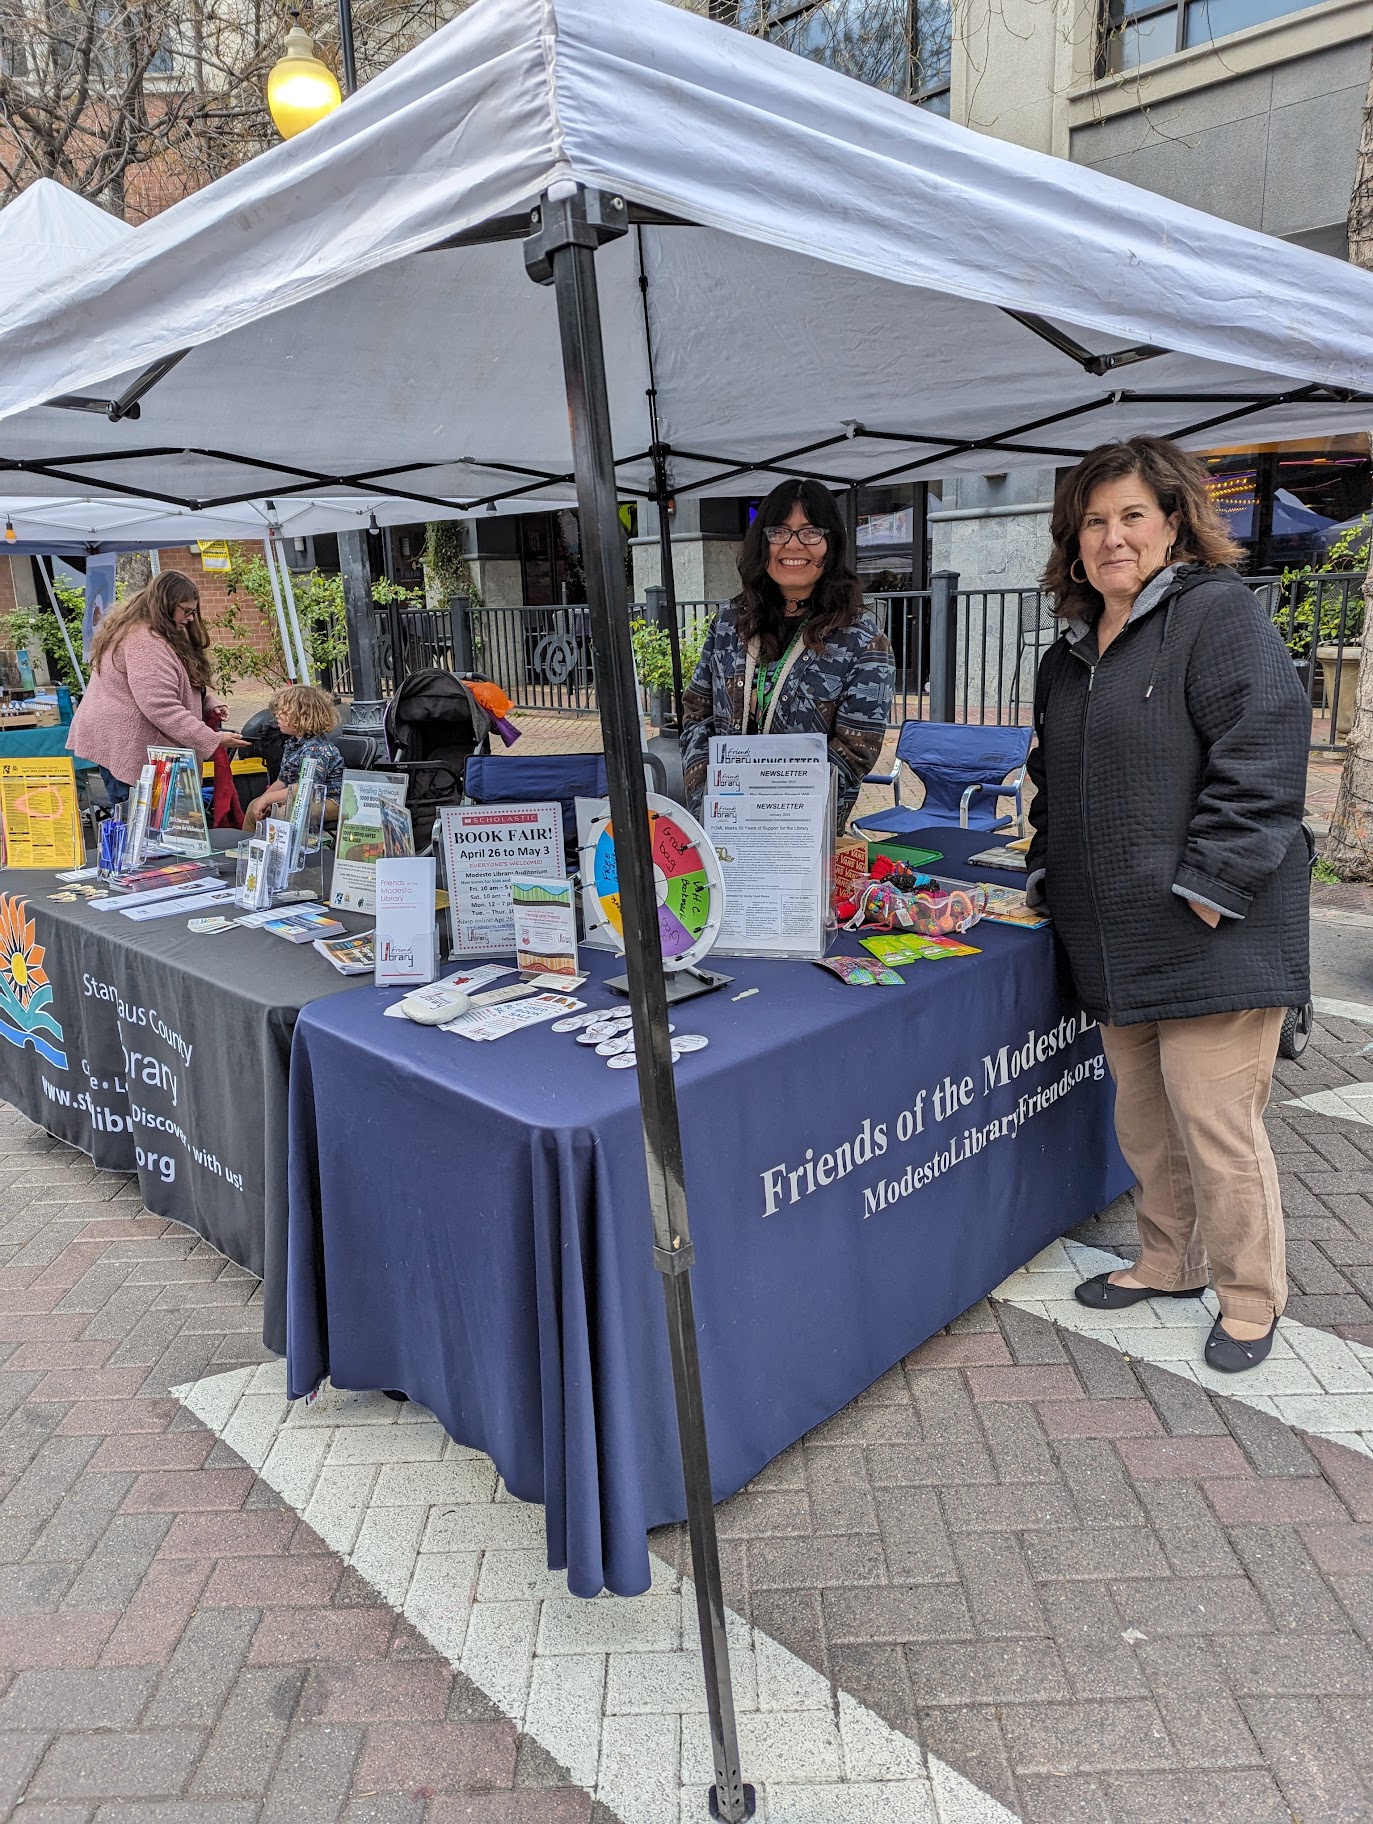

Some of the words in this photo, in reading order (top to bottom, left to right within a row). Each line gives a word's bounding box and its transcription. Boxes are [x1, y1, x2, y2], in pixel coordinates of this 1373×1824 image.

[473, 815, 537, 824] SCHOLASTIC
[763, 825, 779, 833] Support
[793, 825, 809, 833] Library
[454, 829, 503, 845] BOOK
[507, 827, 553, 842] FAIR!
[460, 849, 485, 860] April
[488, 848, 501, 858] 26
[504, 849, 515, 857] to
[518, 846, 541, 857] May
[544, 845, 550, 855] 3
[851, 848, 865, 861] VANS
[469, 860, 509, 869] EVERYONE'S
[510, 859, 543, 867] WELCOME!
[841, 854, 856, 868] VANS
[856, 860, 865, 872] VAN
[465, 871, 492, 879] Modesto
[493, 869, 514, 877] Library
[515, 868, 548, 876] Auditorium
[381, 895, 404, 903] Library
[459, 917, 473, 925] Shop
[148, 1009, 193, 1067] County
[759, 1117, 888, 1218] Friends
[896, 1089, 927, 1142] of
[931, 1073, 975, 1122] the
[981, 1015, 1076, 1096] Modesto
[862, 1053, 1106, 1220] ModestoLibraryFriends.org
[192, 1145, 222, 1177] with
[224, 1166, 244, 1192] us!
